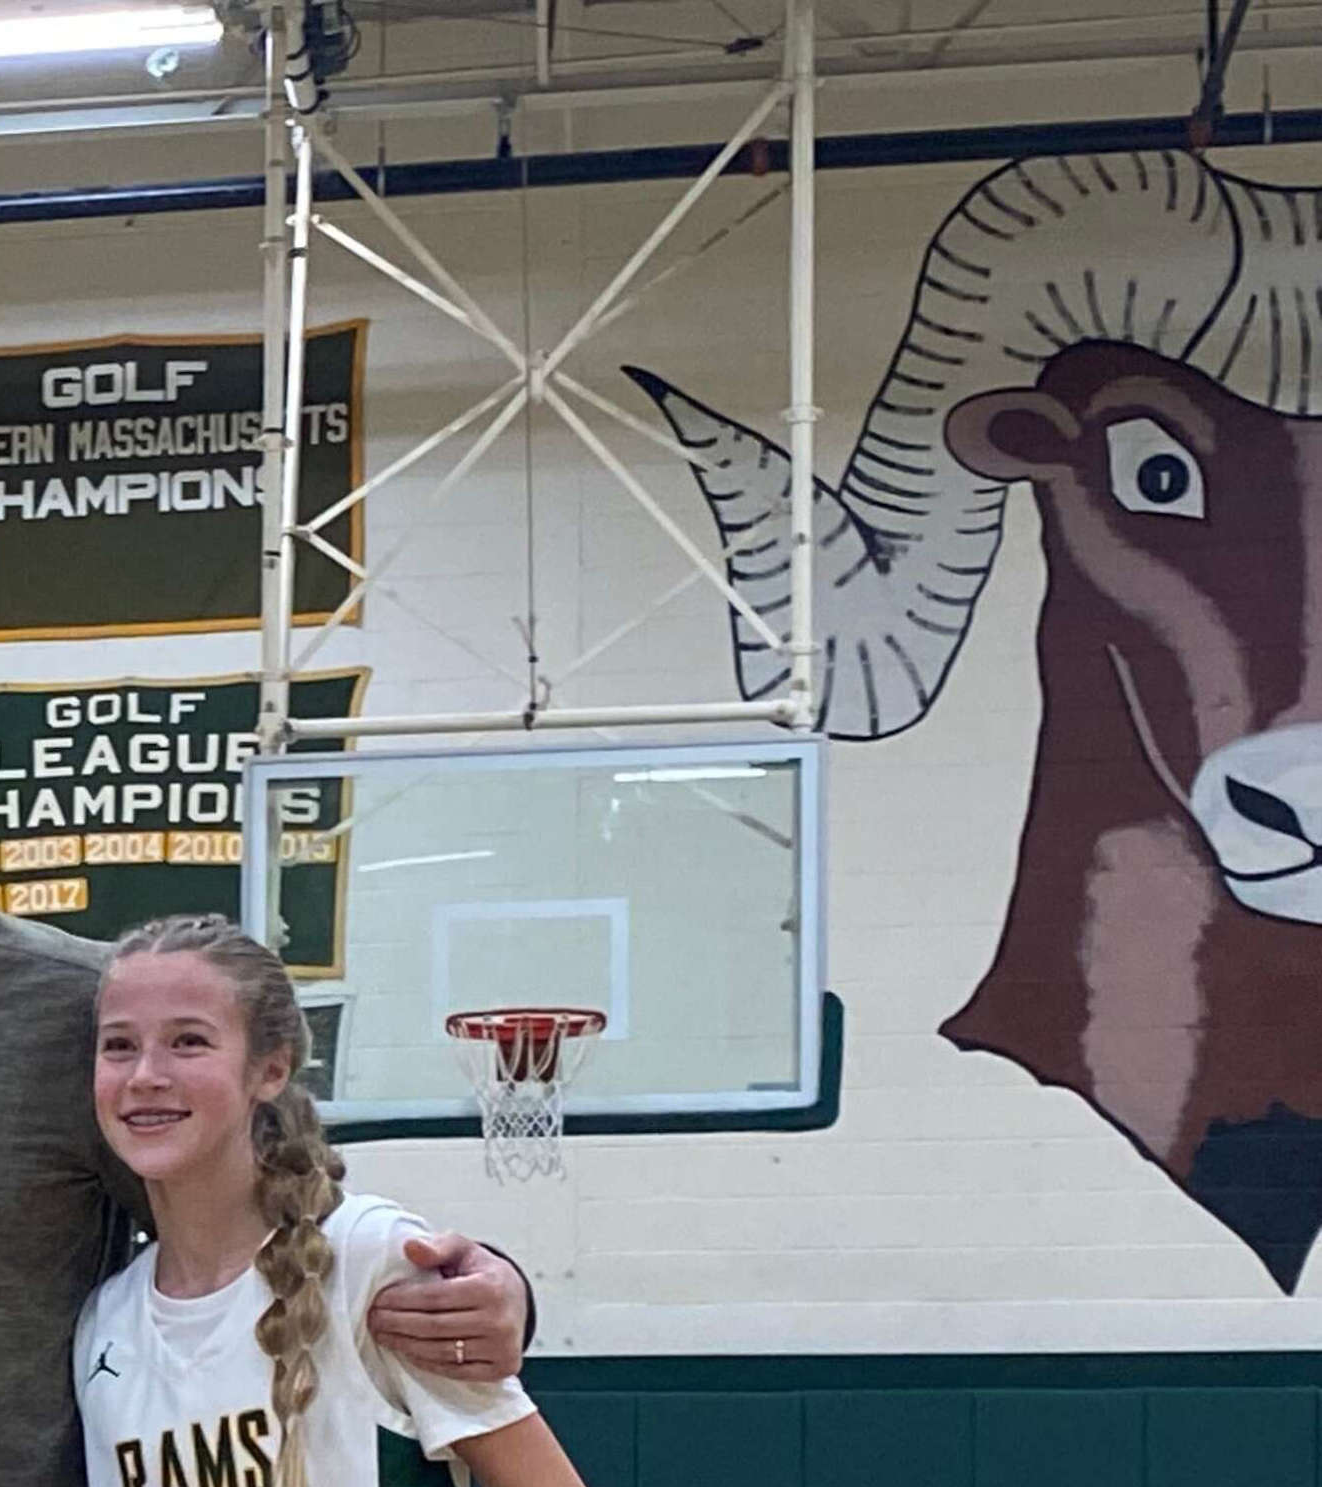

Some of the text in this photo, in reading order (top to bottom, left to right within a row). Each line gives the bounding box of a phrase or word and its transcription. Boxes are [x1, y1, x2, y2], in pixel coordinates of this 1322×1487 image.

[42, 360, 208, 408] GOLF
[68, 402, 349, 463] MASSACHUSTS
[46, 692, 206, 729] GOLF
[87, 836, 162, 865] 2004
[171, 833, 243, 862] 2010
[12, 881, 81, 912] 2017
